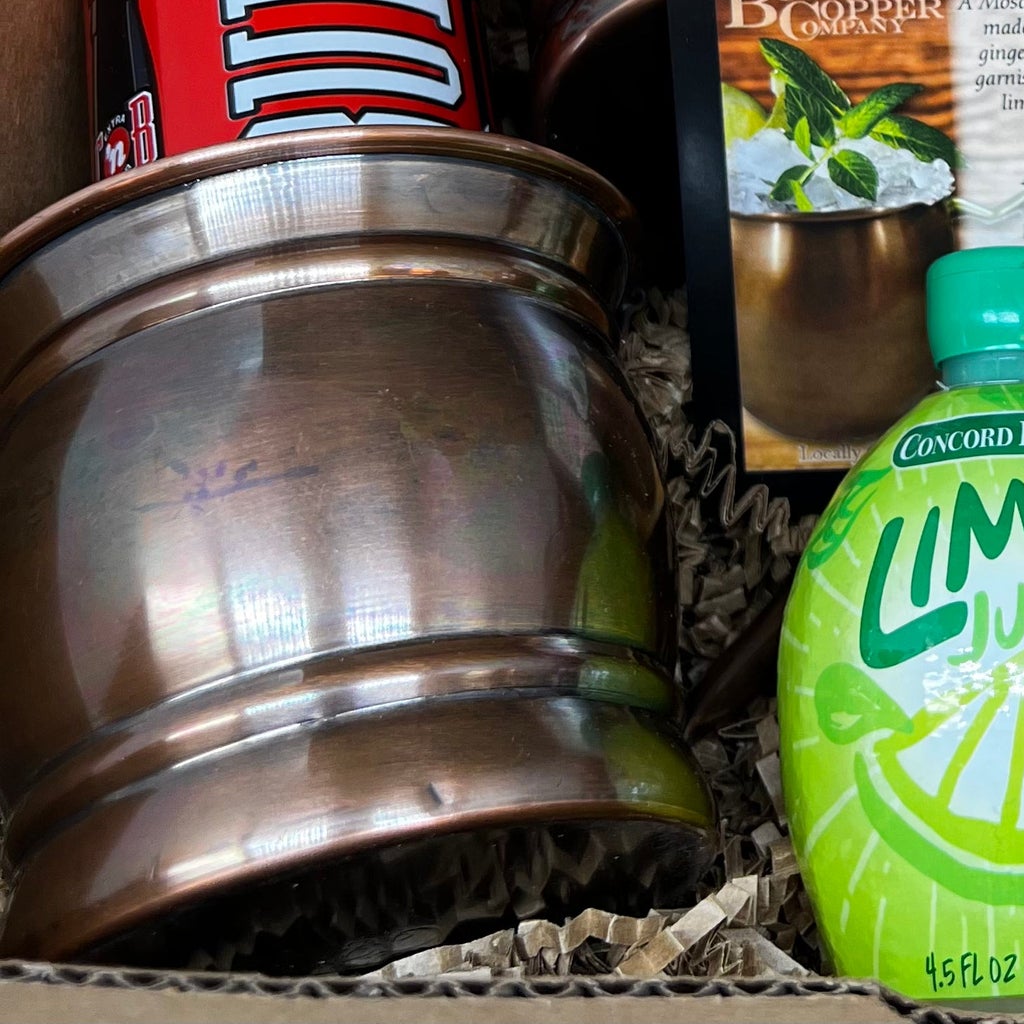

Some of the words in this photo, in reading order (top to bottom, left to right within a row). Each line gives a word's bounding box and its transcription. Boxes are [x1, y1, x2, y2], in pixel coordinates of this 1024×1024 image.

[800, 442, 860, 465] Locally
[899, 424, 1014, 460] CONCORD
[925, 951, 955, 992] 4.5
[961, 952, 984, 988] FL
